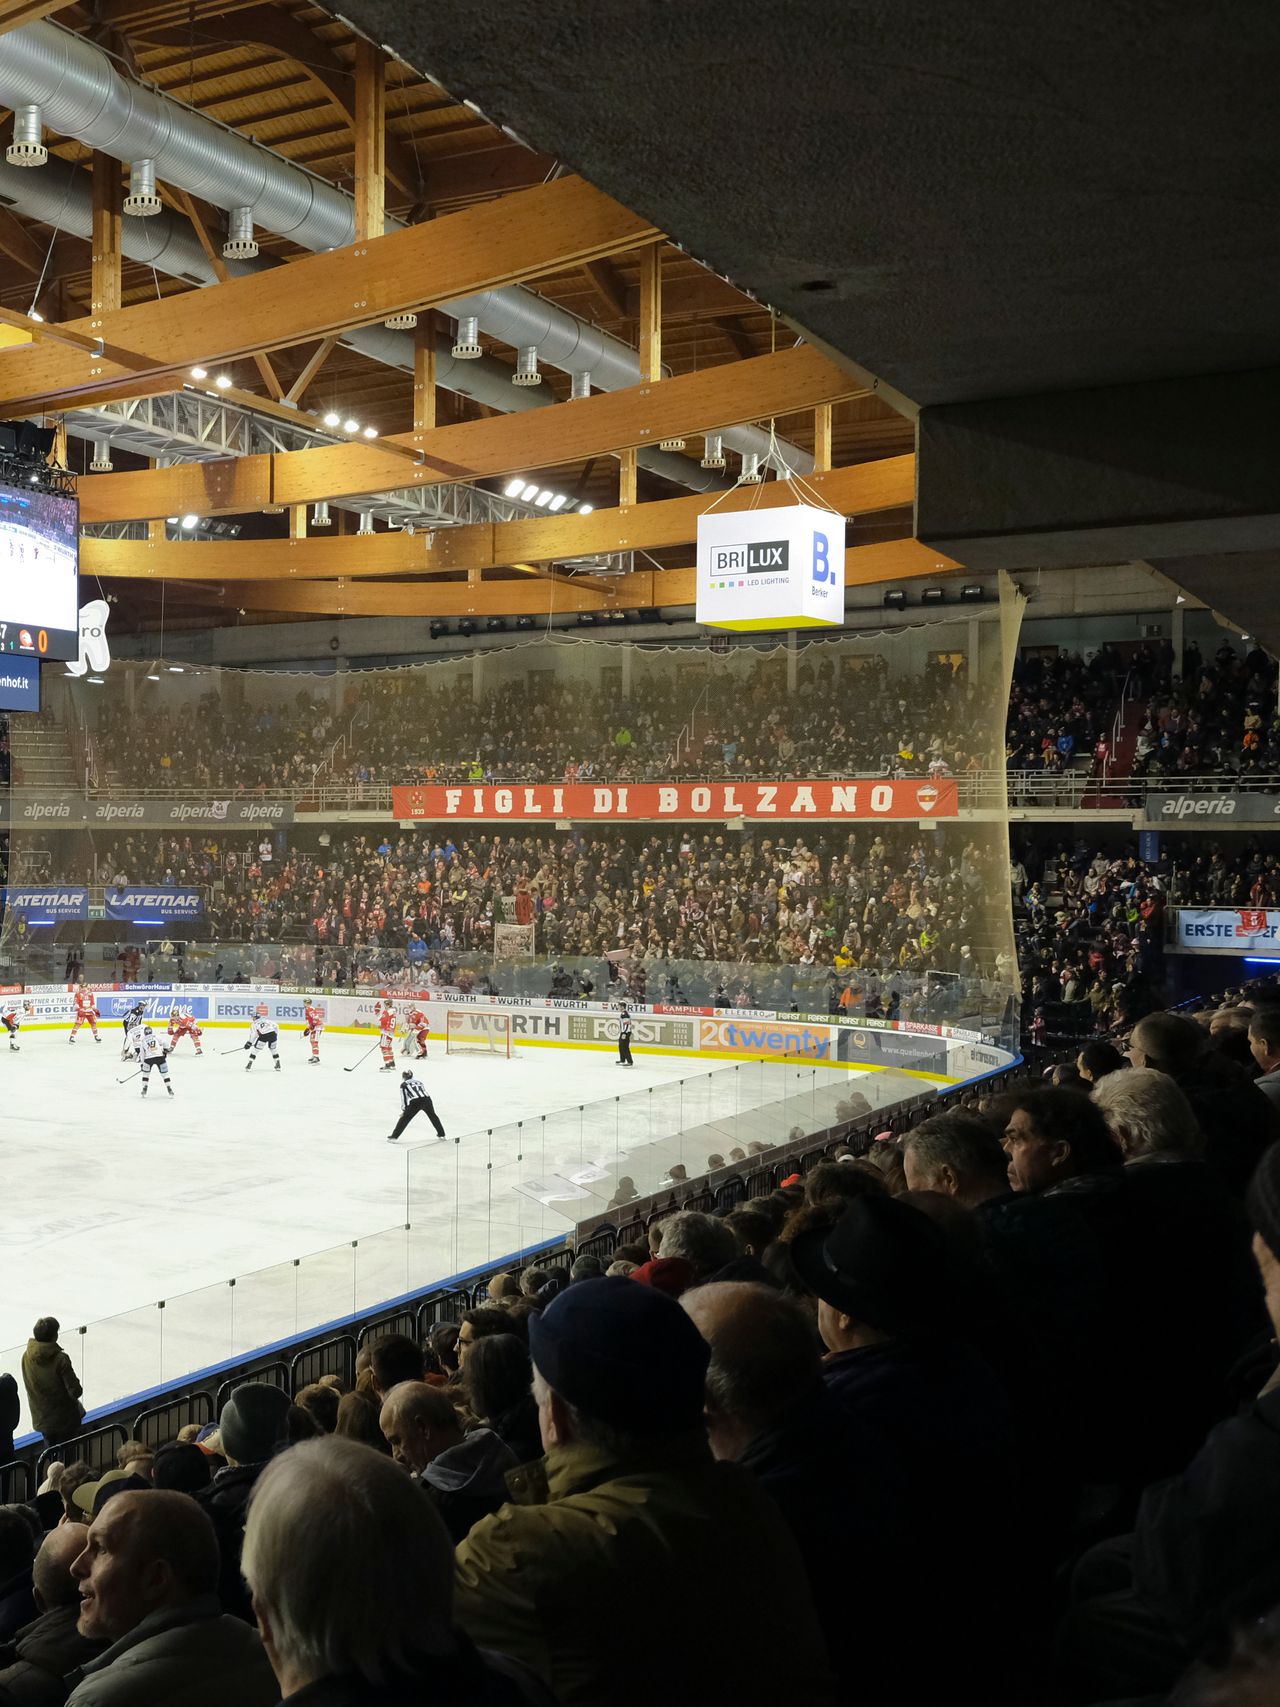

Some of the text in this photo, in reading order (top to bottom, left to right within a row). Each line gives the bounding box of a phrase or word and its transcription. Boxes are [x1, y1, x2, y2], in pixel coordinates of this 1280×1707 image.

[717, 548, 782, 569] BRILUX
[761, 577, 789, 586] LIGHTING
[812, 586, 828, 598] Berker
[0, 643, 5, 651] 3
[38, 629, 48, 653] 0
[446, 788, 564, 813] FIGLI
[594, 788, 628, 813] DI
[658, 786, 893, 812] BOLZANO
[24, 802, 70, 820] alperia
[96, 803, 144, 820] alperia
[240, 803, 283, 821] alperia
[1162, 796, 1236, 819] alperia
[110, 895, 200, 906] LATEMAR
[1185, 924, 1232, 937] ERSTE
[387, 990, 422, 998] KAMPILL
[218, 1005, 305, 1017] ERSTE ERST
[725, 1009, 764, 1017] ELEKTRO
[778, 1012, 800, 1020] FORST
[807, 1014, 830, 1023] FORST
[594, 1018, 666, 1042] FORST
[906, 1022, 938, 1032] SPARKASSE
